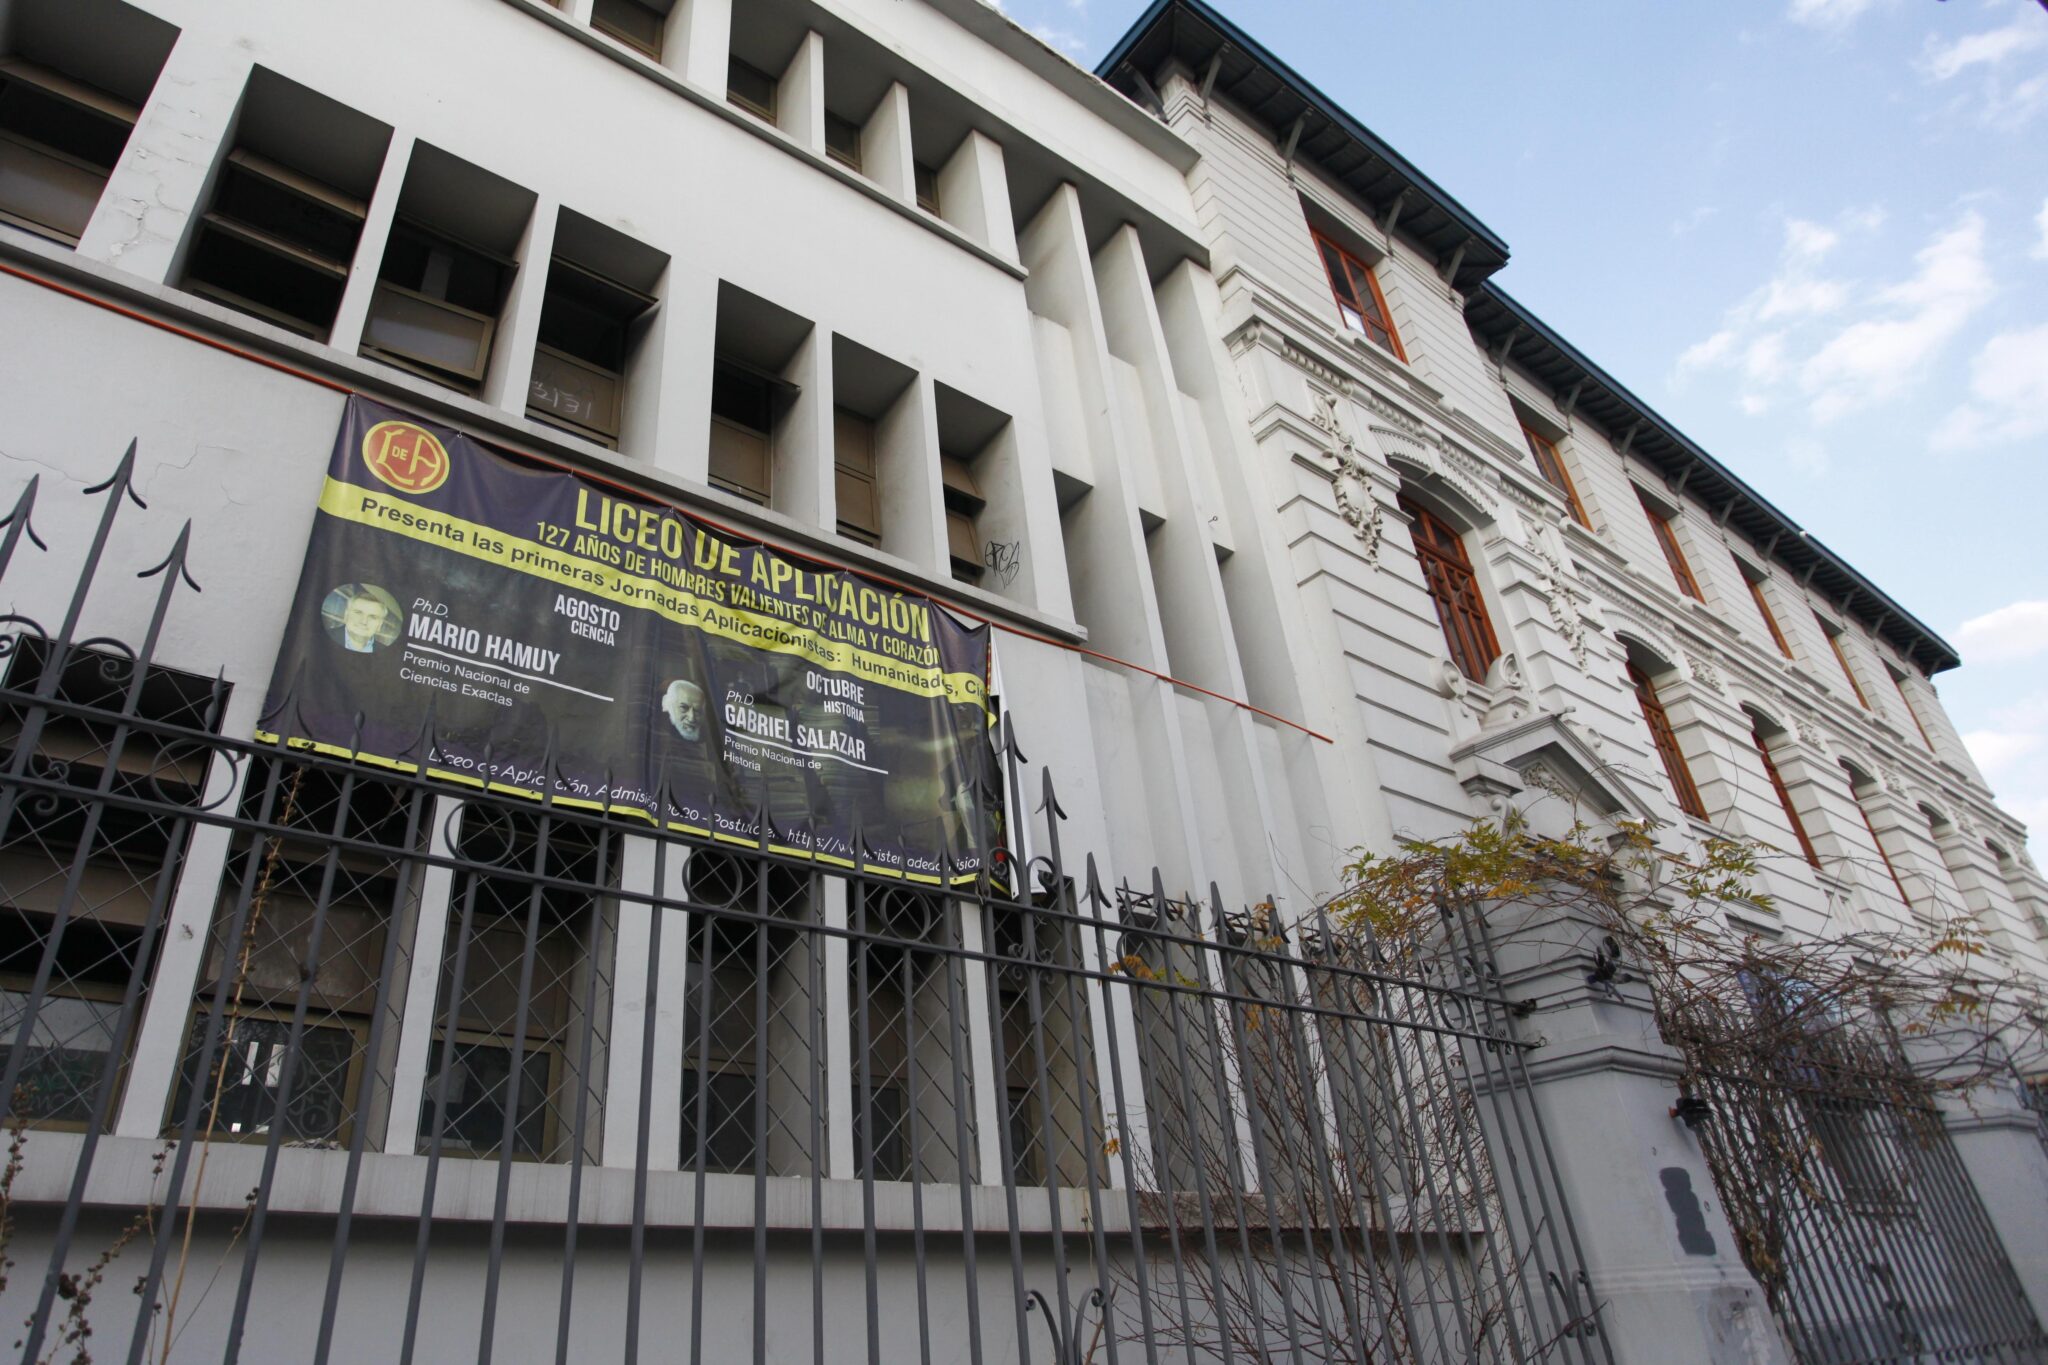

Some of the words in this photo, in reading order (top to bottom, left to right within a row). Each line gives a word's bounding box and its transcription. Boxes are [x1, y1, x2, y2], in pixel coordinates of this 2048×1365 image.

[360, 496, 465, 543] Presenta
[472, 531, 504, 554] las
[510, 547, 605, 586] primeras
[610, 578, 699, 617] Jornadas
[702, 608, 841, 662] Aplicacionistas:
[575, 487, 683, 559] LICEO
[694, 528, 742, 576] DE
[751, 551, 930, 642] APLICACIÓN
[412, 597, 449, 618] Ph.D.
[536, 521, 571, 548] 127
[573, 534, 621, 565] AÑOS
[624, 550, 646, 575] DE
[650, 558, 726, 602] HOMBRES
[731, 583, 809, 625] VALIENTES
[812, 610, 828, 633] DE
[828, 620, 867, 647] ALMA
[870, 631, 879, 650] Y
[882, 634, 941, 667] CORAZÓN
[554, 594, 621, 632] AGOSTO
[408, 613, 480, 654] MARIO
[485, 634, 561, 675] HAMUY
[570, 620, 615, 647] CIENCIA
[399, 667, 458, 692] Ciencias
[462, 684, 513, 706] Exactas
[403, 651, 450, 673] Premio
[454, 664, 511, 689] Nacional
[513, 682, 530, 694] de
[806, 670, 865, 706] OCTUBRE
[725, 690, 755, 708] Ph.D.
[823, 700, 865, 723] HISTORIA
[725, 704, 793, 743] GABRIEL
[796, 724, 866, 761] SALAZAR
[723, 750, 761, 771] Historia
[724, 735, 759, 756] Premio
[761, 747, 805, 768] Nacional
[808, 759, 822, 769] de
[500, 765, 591, 797] Aplicción,
